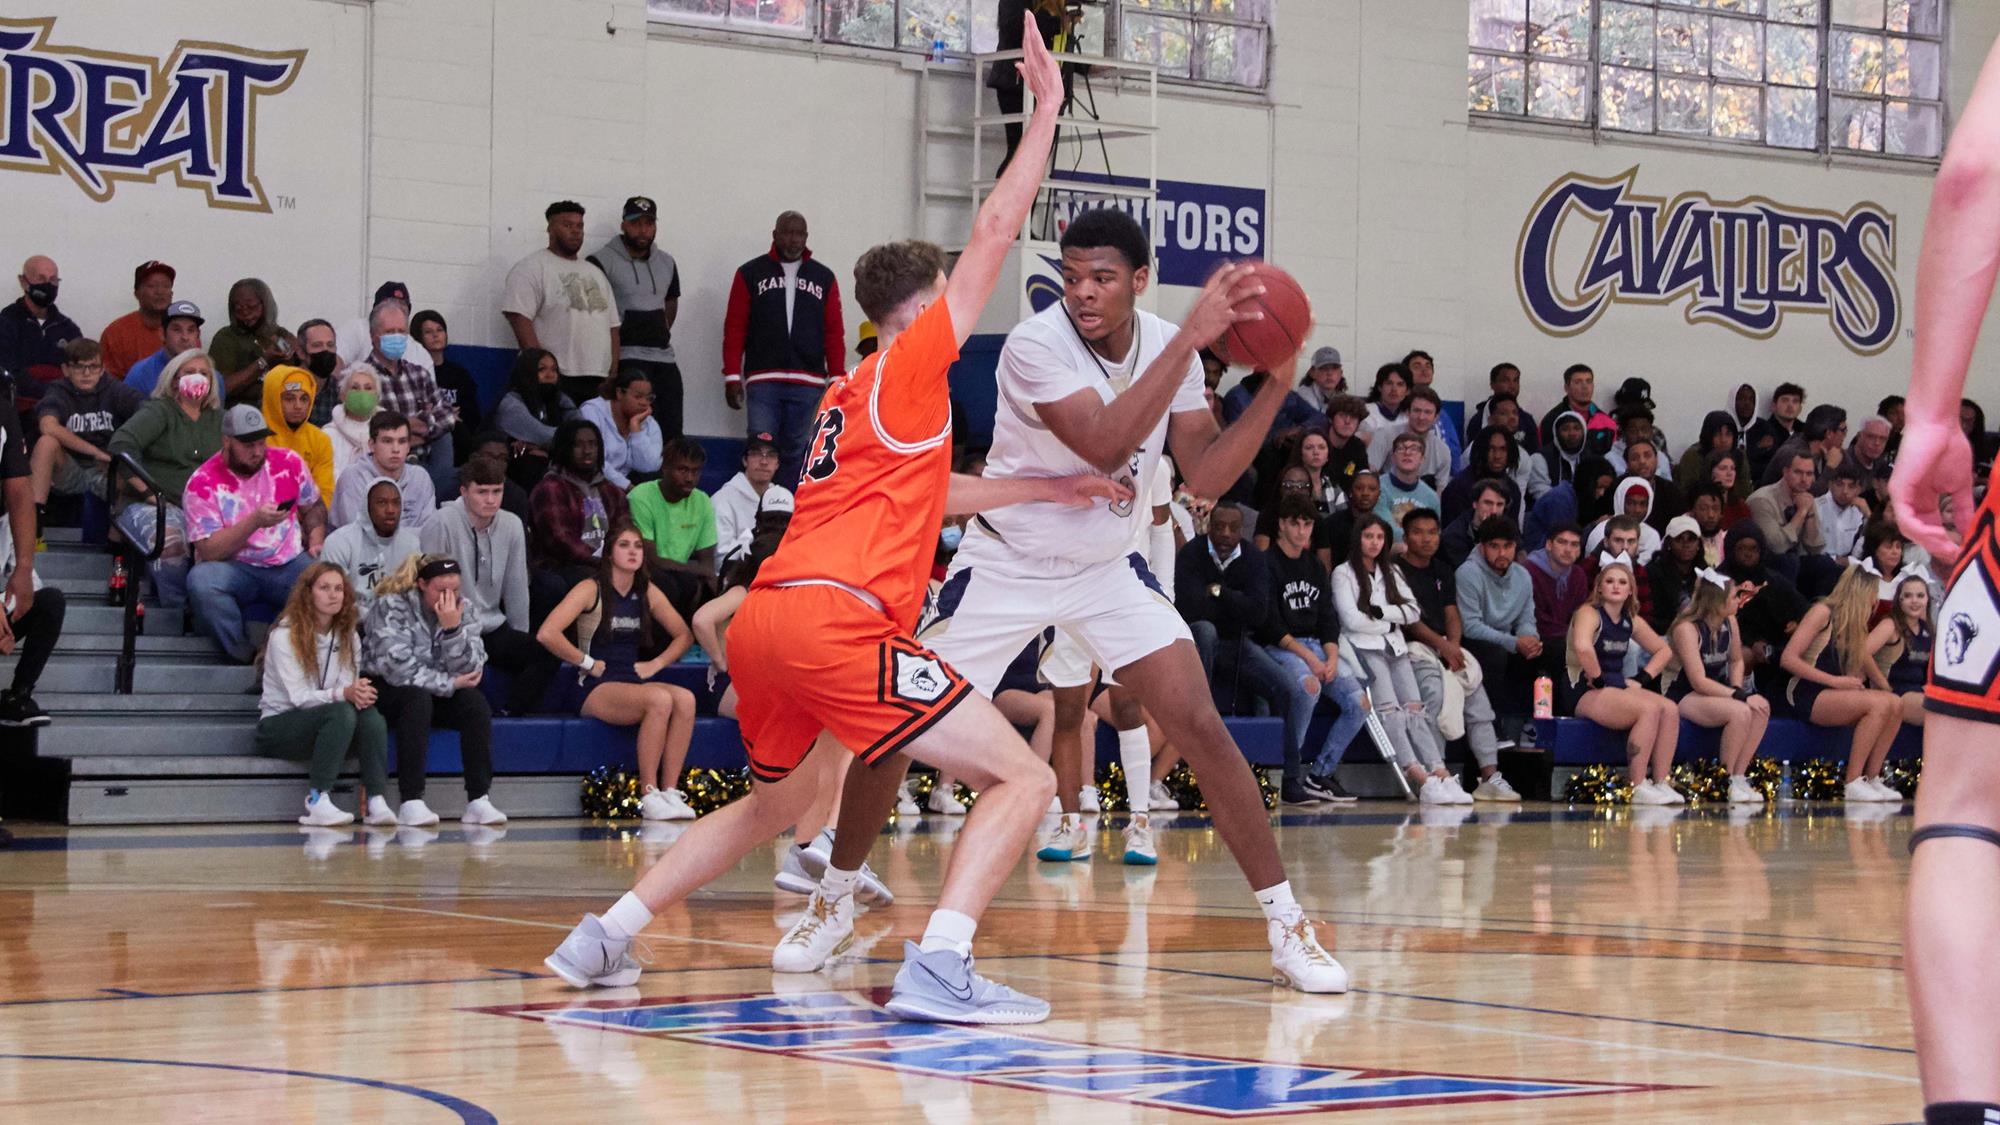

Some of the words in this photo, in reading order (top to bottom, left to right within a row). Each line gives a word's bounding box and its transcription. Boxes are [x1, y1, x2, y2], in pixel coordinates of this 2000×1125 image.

[0, 20, 305, 210] REAT
[1055, 190, 1259, 255] VITORS
[1516, 166, 1900, 355] CAVALIERS
